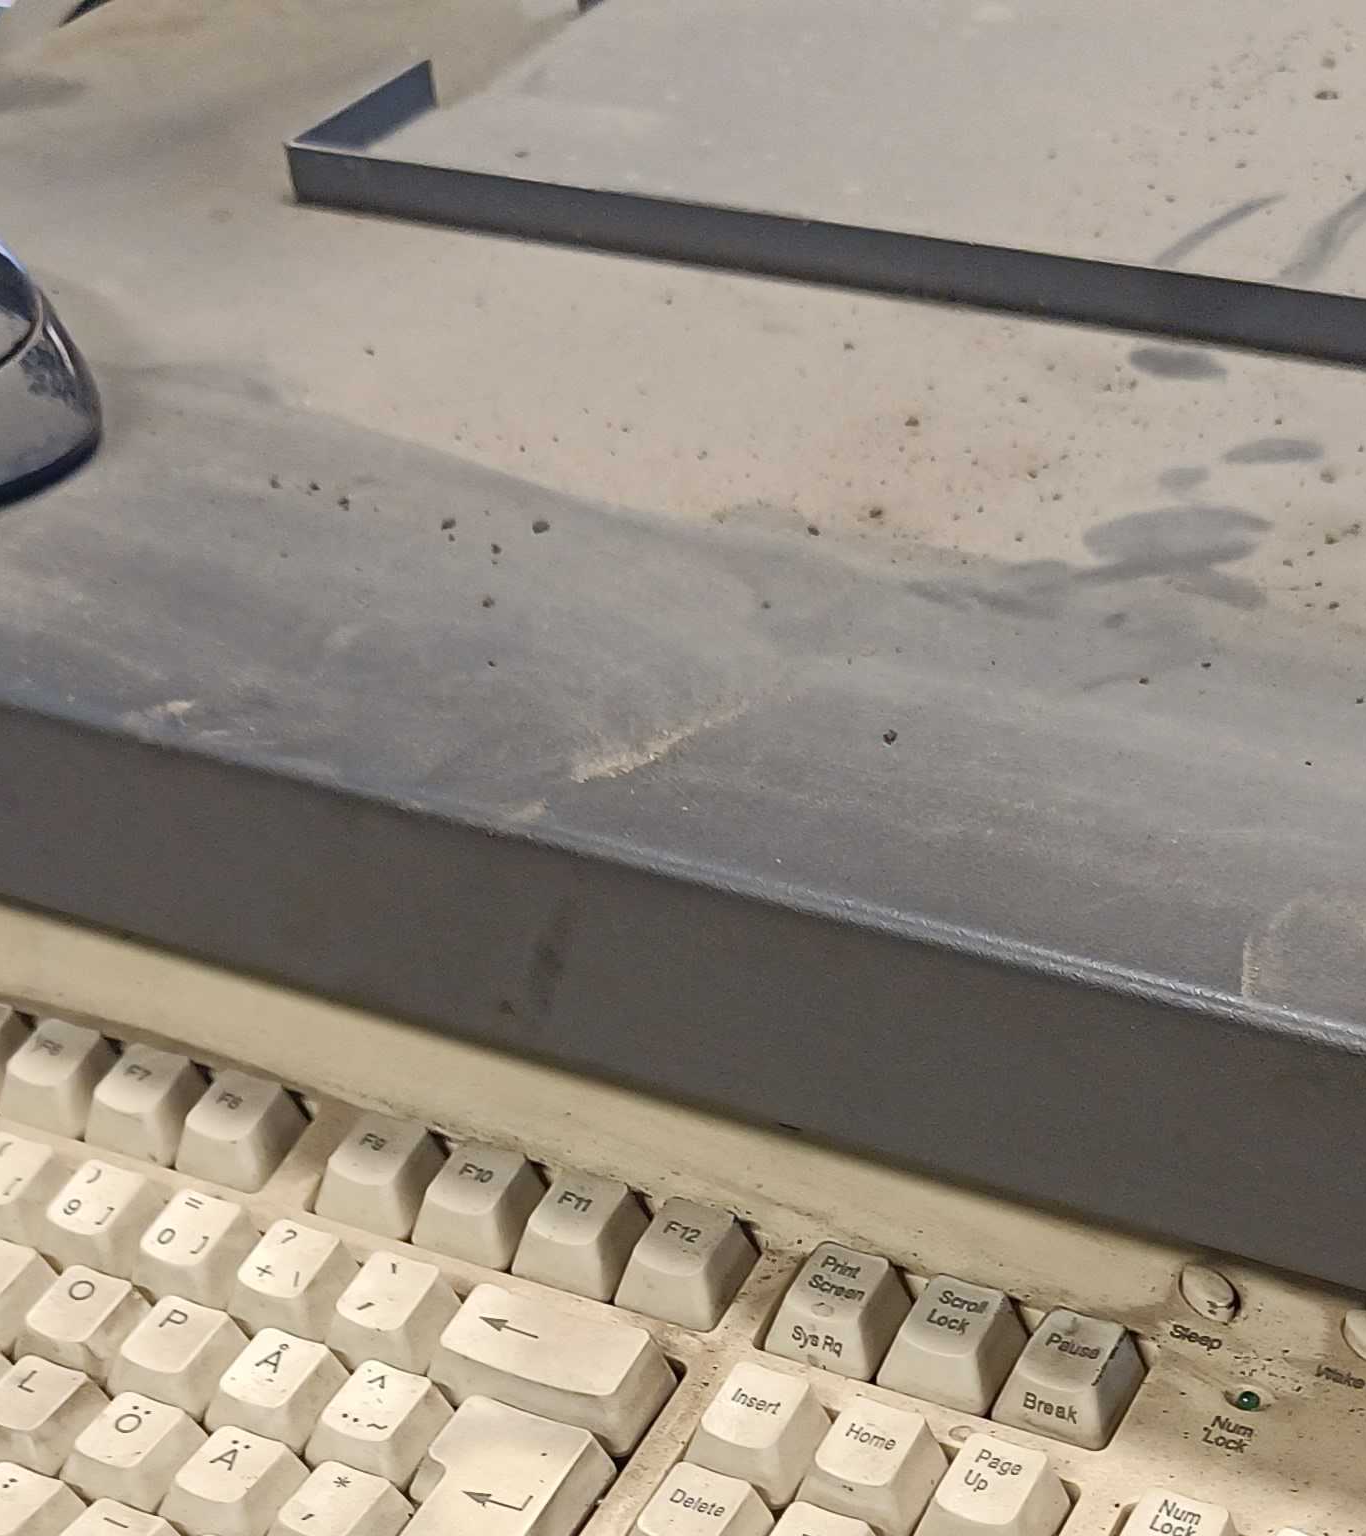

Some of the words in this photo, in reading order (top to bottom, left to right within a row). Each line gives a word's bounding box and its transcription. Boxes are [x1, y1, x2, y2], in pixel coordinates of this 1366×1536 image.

[359, 1132, 386, 1151] F9
[458, 1162, 494, 1183] F10
[557, 1190, 593, 1213] F11
[663, 1220, 701, 1244] F12
[821, 1255, 861, 1279] Print
[68, 1280, 95, 1301] O
[808, 1274, 865, 1301] Screen
[938, 1289, 989, 1315] Scroll
[158, 1309, 189, 1328] P
[926, 1308, 970, 1335] Lock
[791, 1325, 819, 1350] Sys
[822, 1335, 843, 1358] Rq
[1044, 1332, 1101, 1360] Pause
[1169, 1323, 1223, 1352] Sleep
[255, 1343, 290, 1374] Å
[17, 1371, 37, 1393] L
[730, 1388, 781, 1415] Insert
[1022, 1392, 1078, 1424] Break
[114, 1405, 152, 1433] Ö
[1211, 1414, 1256, 1439] Num
[845, 1423, 897, 1451] Home
[1203, 1427, 1250, 1454] Lock
[209, 1439, 251, 1471] Ä
[975, 1449, 1023, 1477] Page
[963, 1468, 989, 1493] Up
[669, 1488, 725, 1517] Delete
[1159, 1499, 1202, 1525] Num
